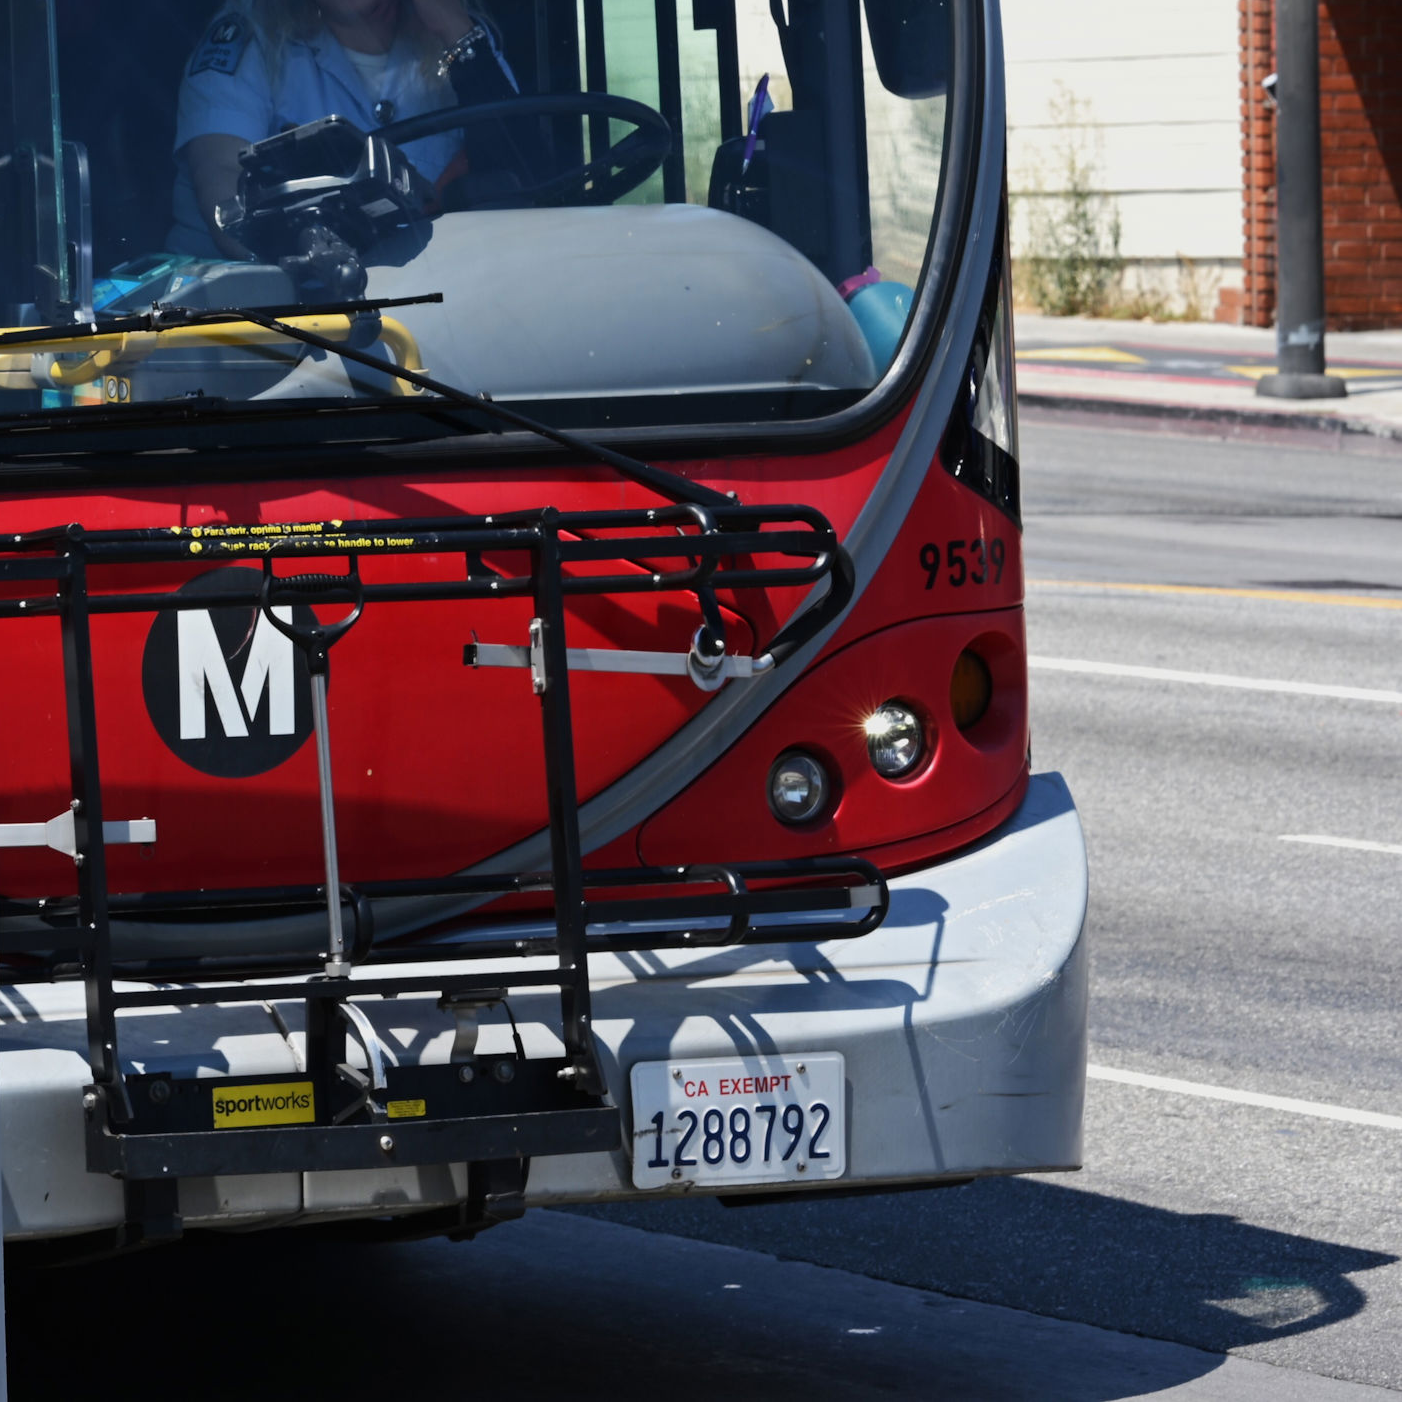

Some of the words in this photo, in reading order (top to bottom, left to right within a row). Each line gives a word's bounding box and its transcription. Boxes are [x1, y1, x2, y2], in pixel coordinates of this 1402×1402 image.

[250, 524, 282, 536] oprima
[292, 523, 323, 533] manija
[337, 537, 372, 548] handle
[374, 537, 385, 547] to
[387, 537, 414, 547] lower
[919, 537, 1006, 591] 9539
[176, 605, 296, 741] M
[684, 1080, 710, 1097] CA
[719, 1075, 792, 1095] EXEMPT
[215, 1090, 310, 1117] sportworks
[647, 1102, 831, 1168] 1288792
